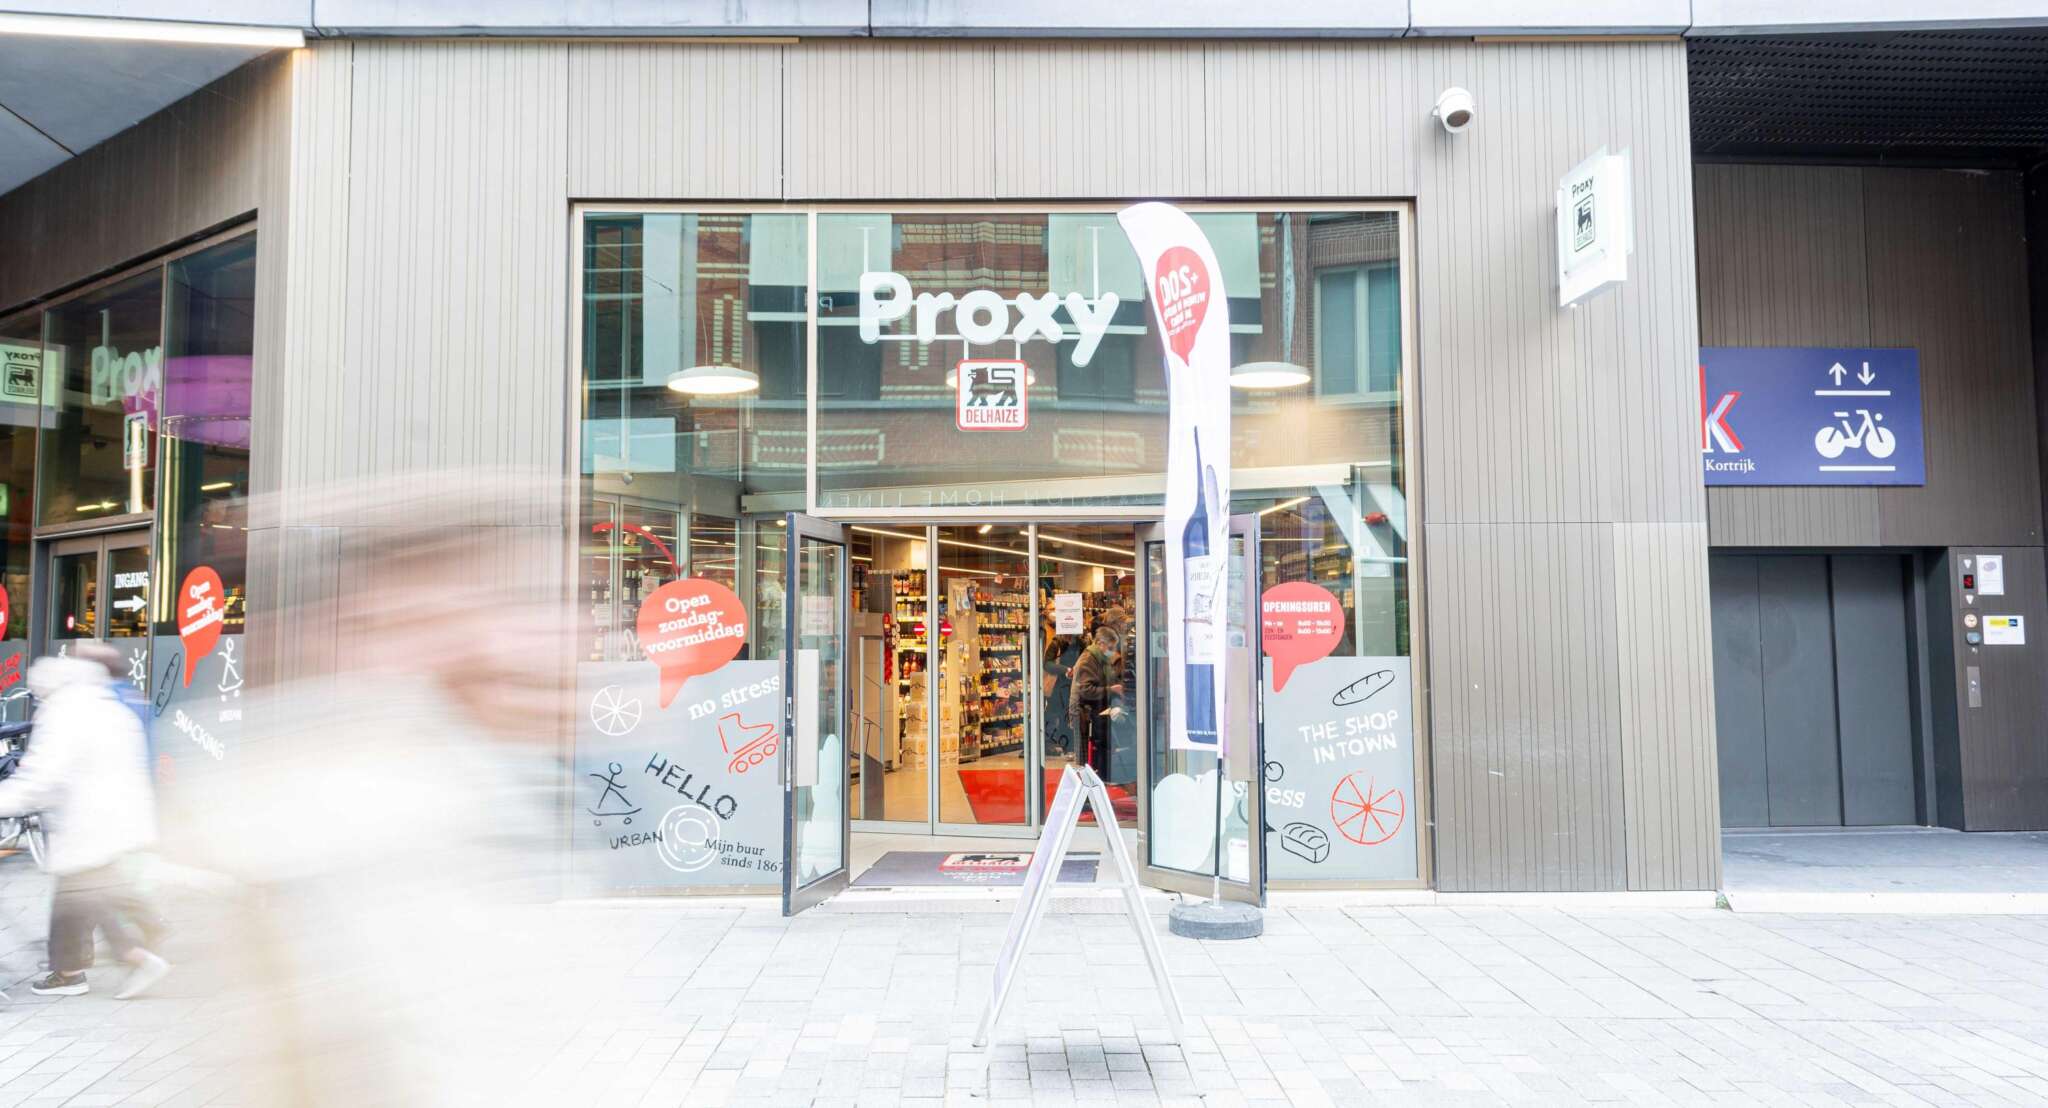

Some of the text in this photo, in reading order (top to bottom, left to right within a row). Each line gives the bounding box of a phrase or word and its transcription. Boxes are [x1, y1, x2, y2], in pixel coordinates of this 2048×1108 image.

[1571, 175, 1594, 198] Proxy
[858, 271, 1119, 368] Proxy
[91, 346, 161, 406] Prox
[965, 408, 1019, 424] DELHAIZE
[1705, 458, 1756, 474] Kortrijk
[114, 572, 149, 589] INGANG
[665, 594, 712, 613] Open
[1264, 601, 1331, 613] OPENINGSUREN
[658, 610, 724, 635] zondag-
[646, 622, 745, 655] voormiddag
[688, 675, 780, 721] no stress
[1298, 709, 1399, 745] THE SHOP
[1312, 732, 1398, 765] IN TOWN
[644, 751, 738, 821] HELLO
[609, 831, 664, 851] URBAN
[704, 837, 765, 857] Mijn buur
[720, 854, 753, 870] sinds
